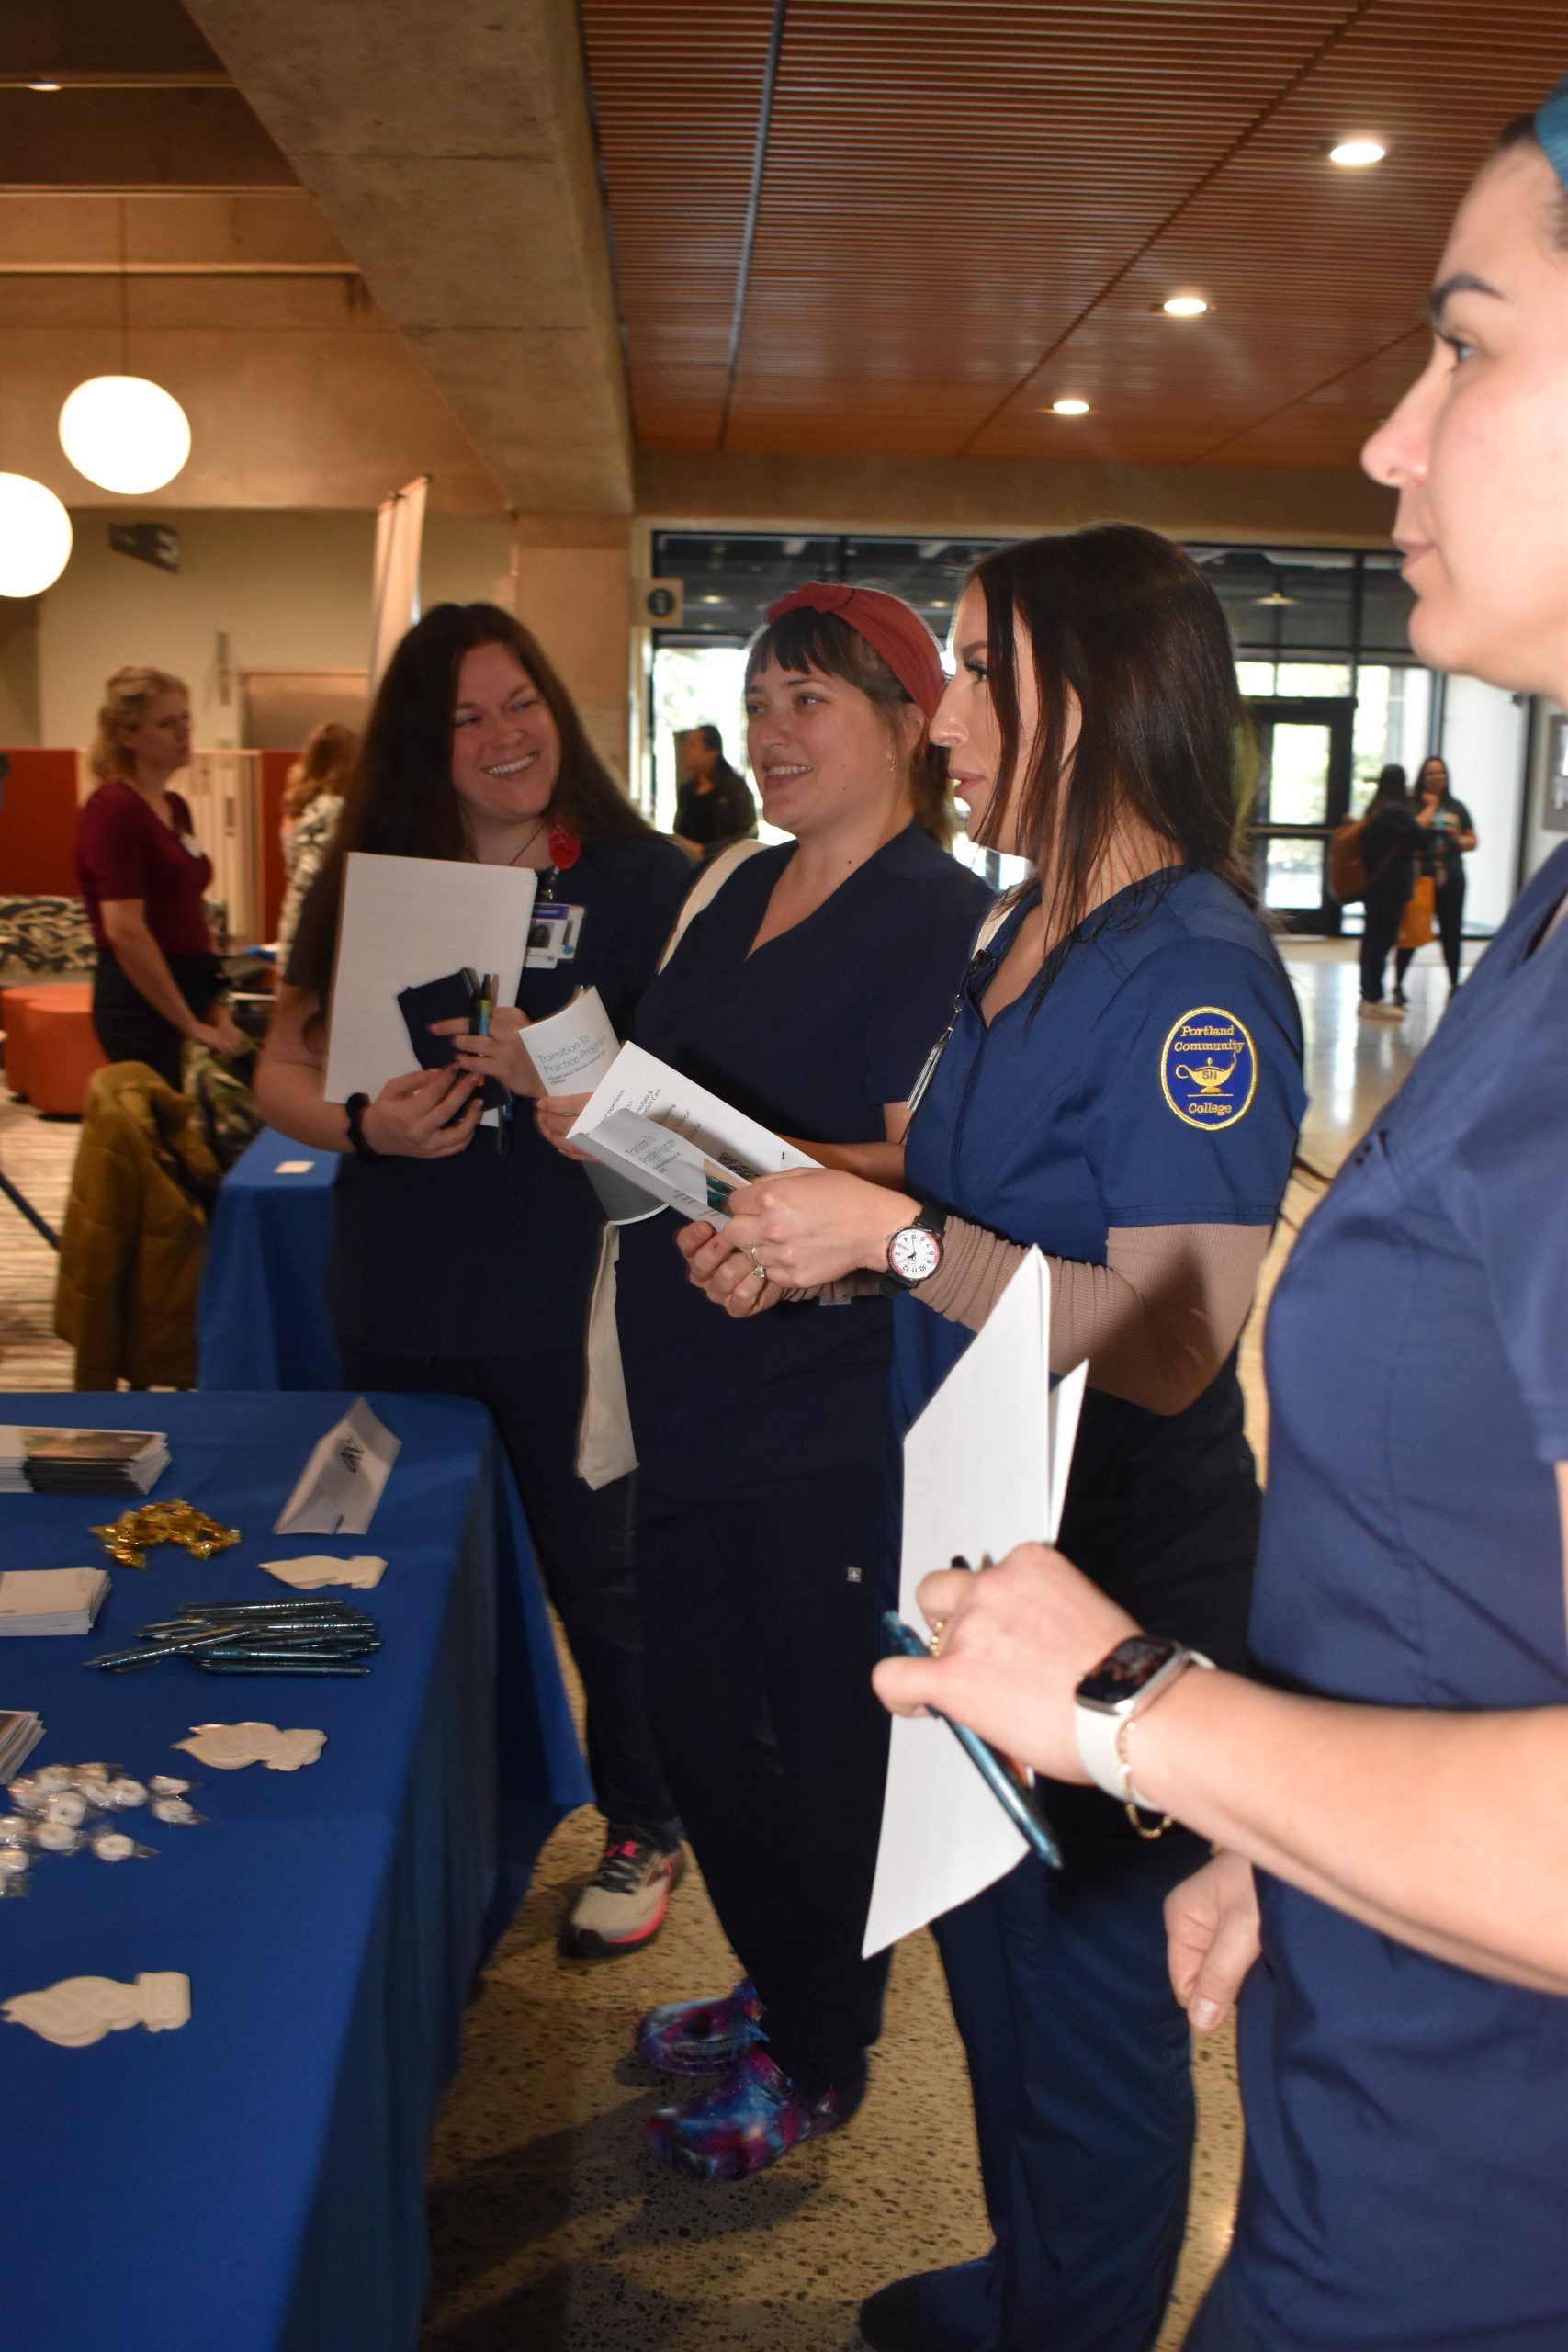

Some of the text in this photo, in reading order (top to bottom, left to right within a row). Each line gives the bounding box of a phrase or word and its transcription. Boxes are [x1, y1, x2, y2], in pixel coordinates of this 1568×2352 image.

[1180, 1025, 1235, 1037] Portland
[536, 1035, 590, 1064] Transition To
[1174, 1039, 1246, 1053] Community
[544, 1057, 580, 1074] Practice
[1201, 1070, 1218, 1080] SN
[1188, 1102, 1233, 1116] College
